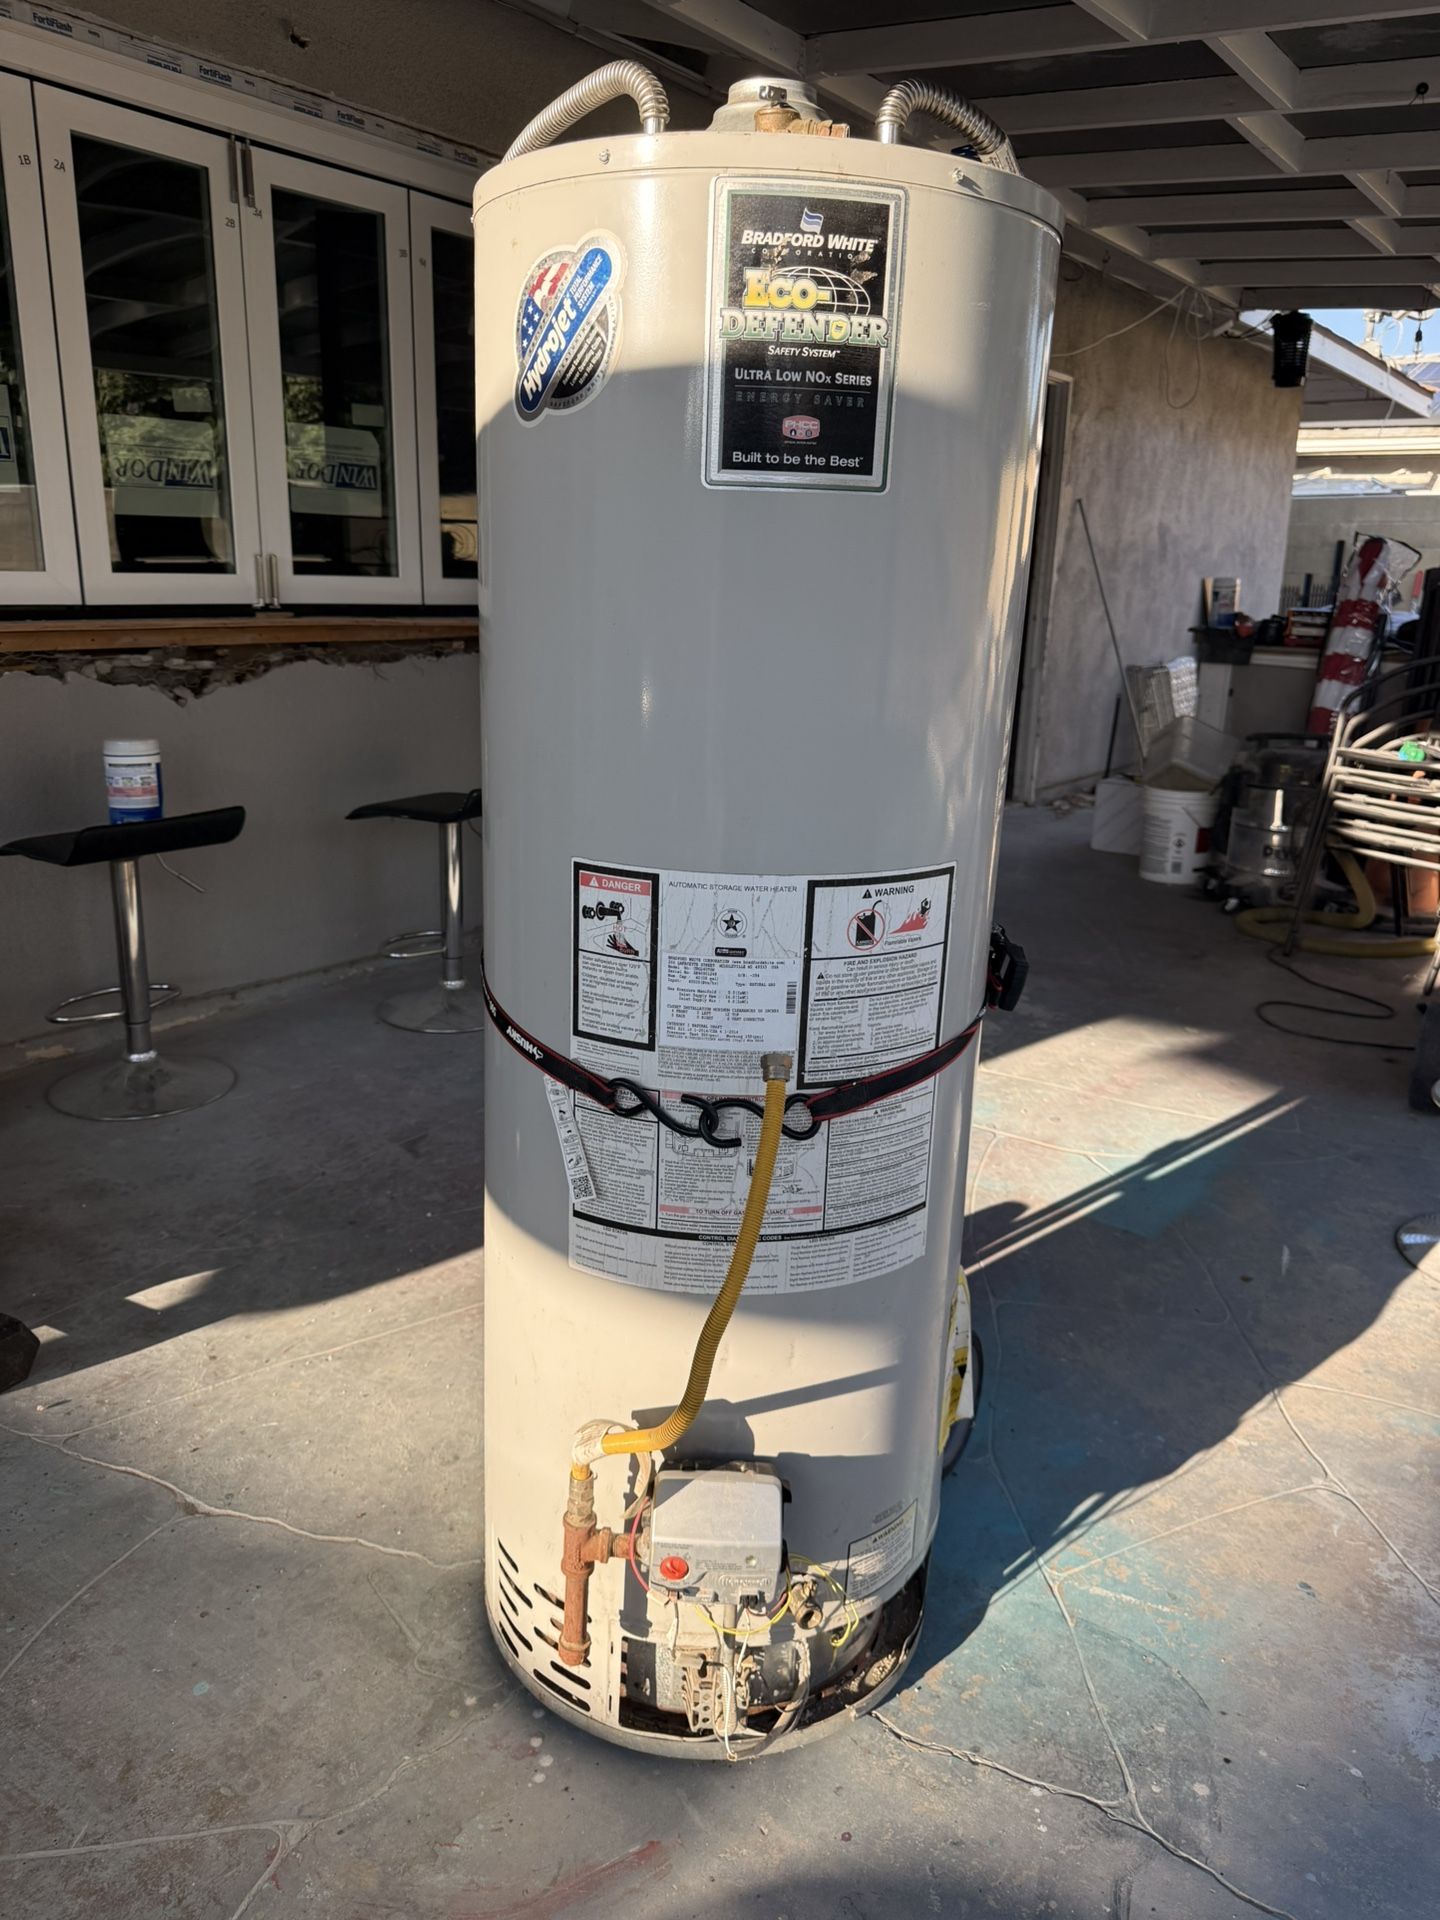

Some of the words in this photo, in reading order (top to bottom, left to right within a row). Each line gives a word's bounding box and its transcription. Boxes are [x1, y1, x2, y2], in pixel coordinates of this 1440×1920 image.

[18, 154, 31, 166] 1B
[53, 158, 66, 173] 2A
[741, 230, 824, 249] BRADFORD
[827, 234, 877, 253] WHITE
[719, 307, 889, 348] DEFENDER
[522, 296, 577, 402] Hydrojet
[767, 345, 801, 357] SAFETY
[734, 367, 772, 382] ULTRA
[775, 369, 802, 382] LOW
[835, 372, 872, 387] SERIES
[813, 394, 866, 409] SAVER
[732, 451, 762, 463] Built
[766, 453, 780, 464] to
[783, 453, 801, 465] be
[804, 454, 826, 466] the
[829, 455, 860, 468] Best
[602, 878, 642, 892] DANGER
[668, 880, 708, 890] AUTOMATIC
[710, 882, 742, 892] STORAGE
[874, 885, 914, 898] WARNING
[506, 1026, 534, 1054] HUSKY
